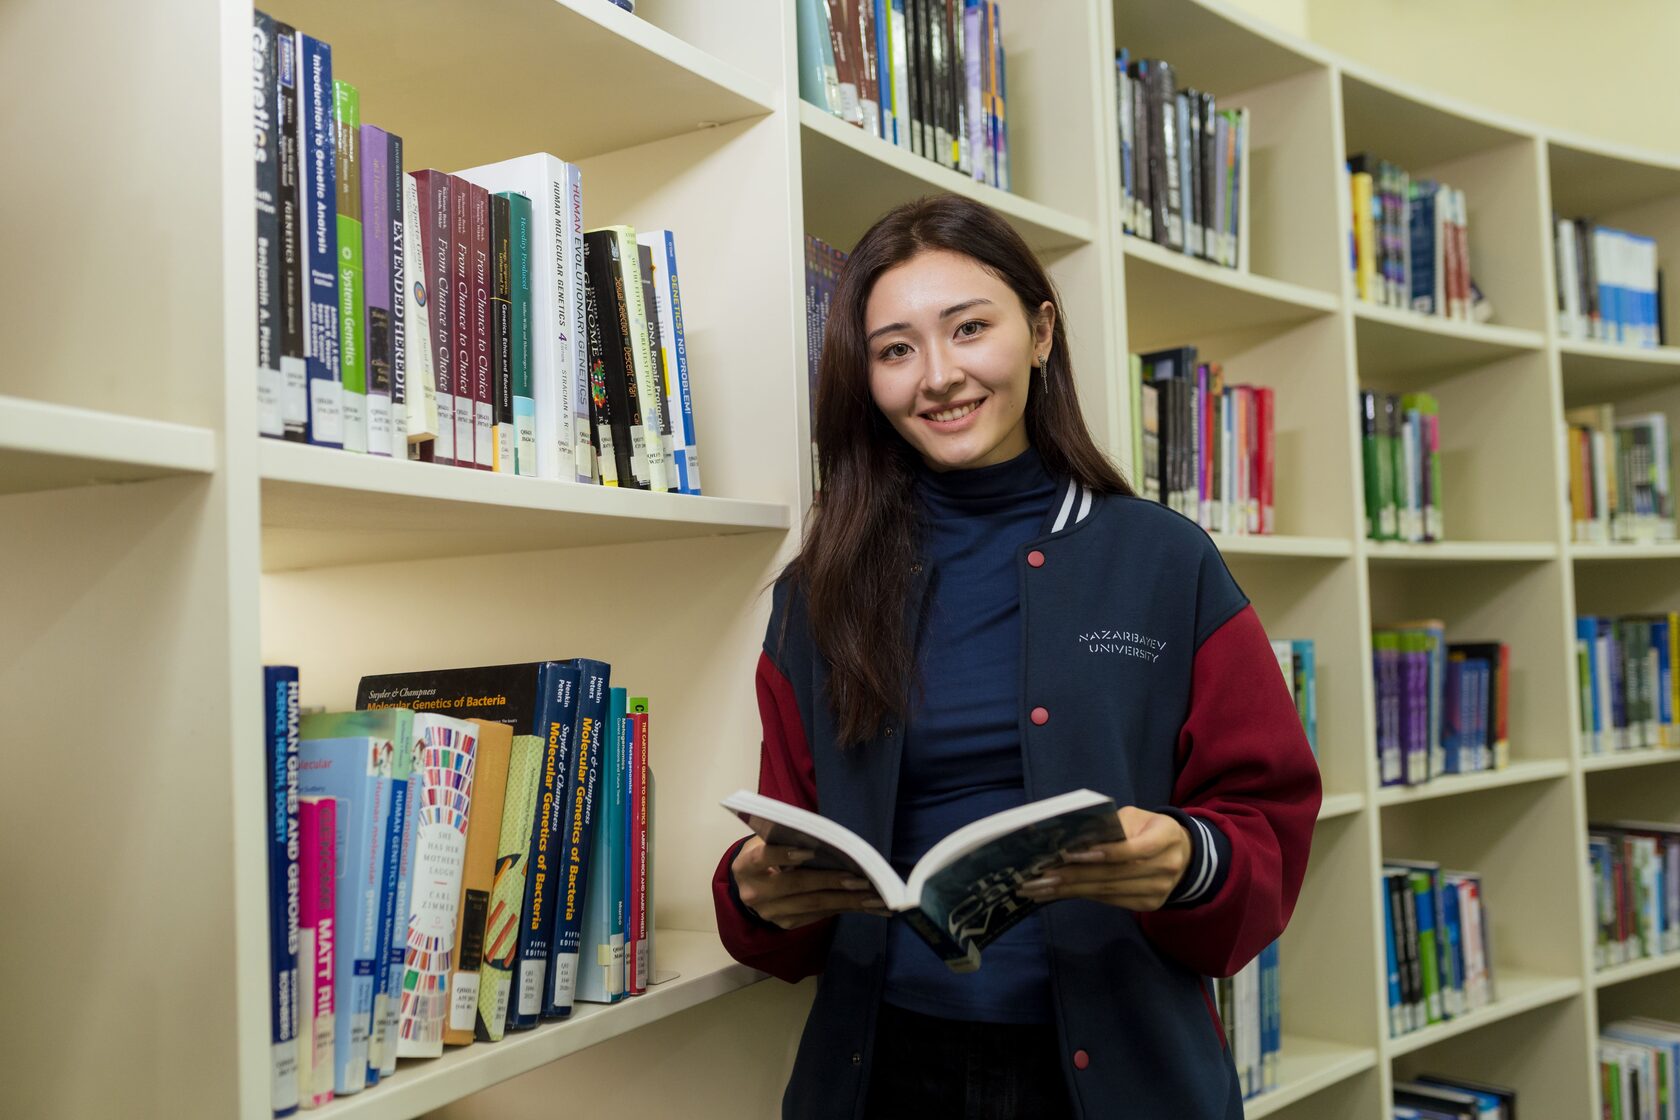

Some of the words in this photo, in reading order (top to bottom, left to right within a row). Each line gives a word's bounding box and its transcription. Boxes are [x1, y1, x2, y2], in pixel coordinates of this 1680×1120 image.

[313, 55, 323, 128] Introduction
[316, 134, 323, 146] to
[315, 149, 325, 198] Genetic
[315, 201, 328, 254] Analysis
[573, 184, 581, 233] HUMAN
[438, 238, 448, 272] From
[520, 217, 528, 251] Heredity
[555, 218, 564, 276] MOLECULAR
[258, 237, 269, 305] Benjamin
[394, 220, 404, 318] EXTENDED
[458, 243, 467, 277] From
[477, 250, 486, 284] From
[341, 268, 354, 315] Systems
[438, 277, 448, 326] Chance
[459, 282, 468, 329] Chance
[558, 279, 566, 326] GENETICS
[574, 237, 584, 337] EVOLUTIONARY
[615, 276, 625, 300] Sexual
[671, 275, 682, 335] GENETICS?
[260, 309, 269, 323] A.
[478, 288, 487, 335] Chance
[584, 272, 599, 357] GENOME
[618, 302, 629, 336] Selection
[344, 318, 355, 366] Genetics
[439, 330, 448, 342] to
[459, 334, 468, 346] to
[479, 340, 487, 351] to
[558, 333, 567, 342] 4
[640, 333, 648, 368] GREATEST
[648, 322, 656, 347] DNA
[677, 338, 684, 354] NO
[394, 320, 405, 400] HEREDIT
[440, 347, 449, 391] Choice
[460, 350, 469, 393] Choice
[479, 356, 488, 398] Choice
[578, 340, 587, 405] GENETICS
[624, 346, 635, 376] Descent
[650, 351, 662, 385] Repair
[628, 383, 636, 397] Man
[679, 357, 692, 414] PROBLEM!
[655, 386, 665, 432] Protocols
[1079, 630, 1166, 650] NAZARBAYEV
[1089, 644, 1159, 663] UNIVERSITY
[274, 681, 286, 735] SCIENCE,
[368, 690, 390, 701] Snyder
[391, 689, 398, 698] &
[399, 688, 436, 699] Champness
[368, 701, 410, 711] Molecular
[412, 698, 452, 710] Genetics
[454, 697, 465, 708] of
[466, 694, 506, 707] Bacteria
[556, 679, 565, 703] Peters
[564, 680, 572, 708] Henkin
[589, 676, 597, 699] Peters
[287, 681, 299, 751] HUMAN
[544, 721, 560, 788] Molecular
[558, 724, 570, 761] Snyder
[579, 717, 592, 784] Molecular
[590, 720, 601, 757] Snyder
[274, 737, 286, 790] HEALTH,
[300, 758, 333, 770] lecular
[558, 762, 565, 771] &
[590, 758, 598, 767] &
[287, 756, 299, 814] GENES
[372, 781, 383, 823] Human
[405, 777, 417, 816] Human
[552, 774, 565, 832] Champness
[584, 768, 597, 825] Champness
[642, 786, 646, 794] TO
[275, 792, 286, 844] SOCIETY
[392, 790, 404, 833] HUMAN
[538, 792, 554, 852] Genetics
[571, 786, 586, 844] Genetics
[287, 818, 299, 860] AND
[318, 807, 332, 910] GENOME
[424, 854, 460, 865] MOTHER'S
[428, 842, 443, 850] HAS
[570, 848, 580, 862] of
[537, 854, 546, 871] of
[288, 864, 299, 955] GENOMES
[394, 880, 408, 942] genetics
[422, 901, 454, 912] ZIMMER
[429, 892, 450, 900] CARL
[531, 873, 546, 930] Bacteria
[566, 864, 579, 921] Bacteria
[363, 889, 376, 953] genetics
[318, 918, 333, 981] MATT
[531, 940, 546, 948] FIFTH
